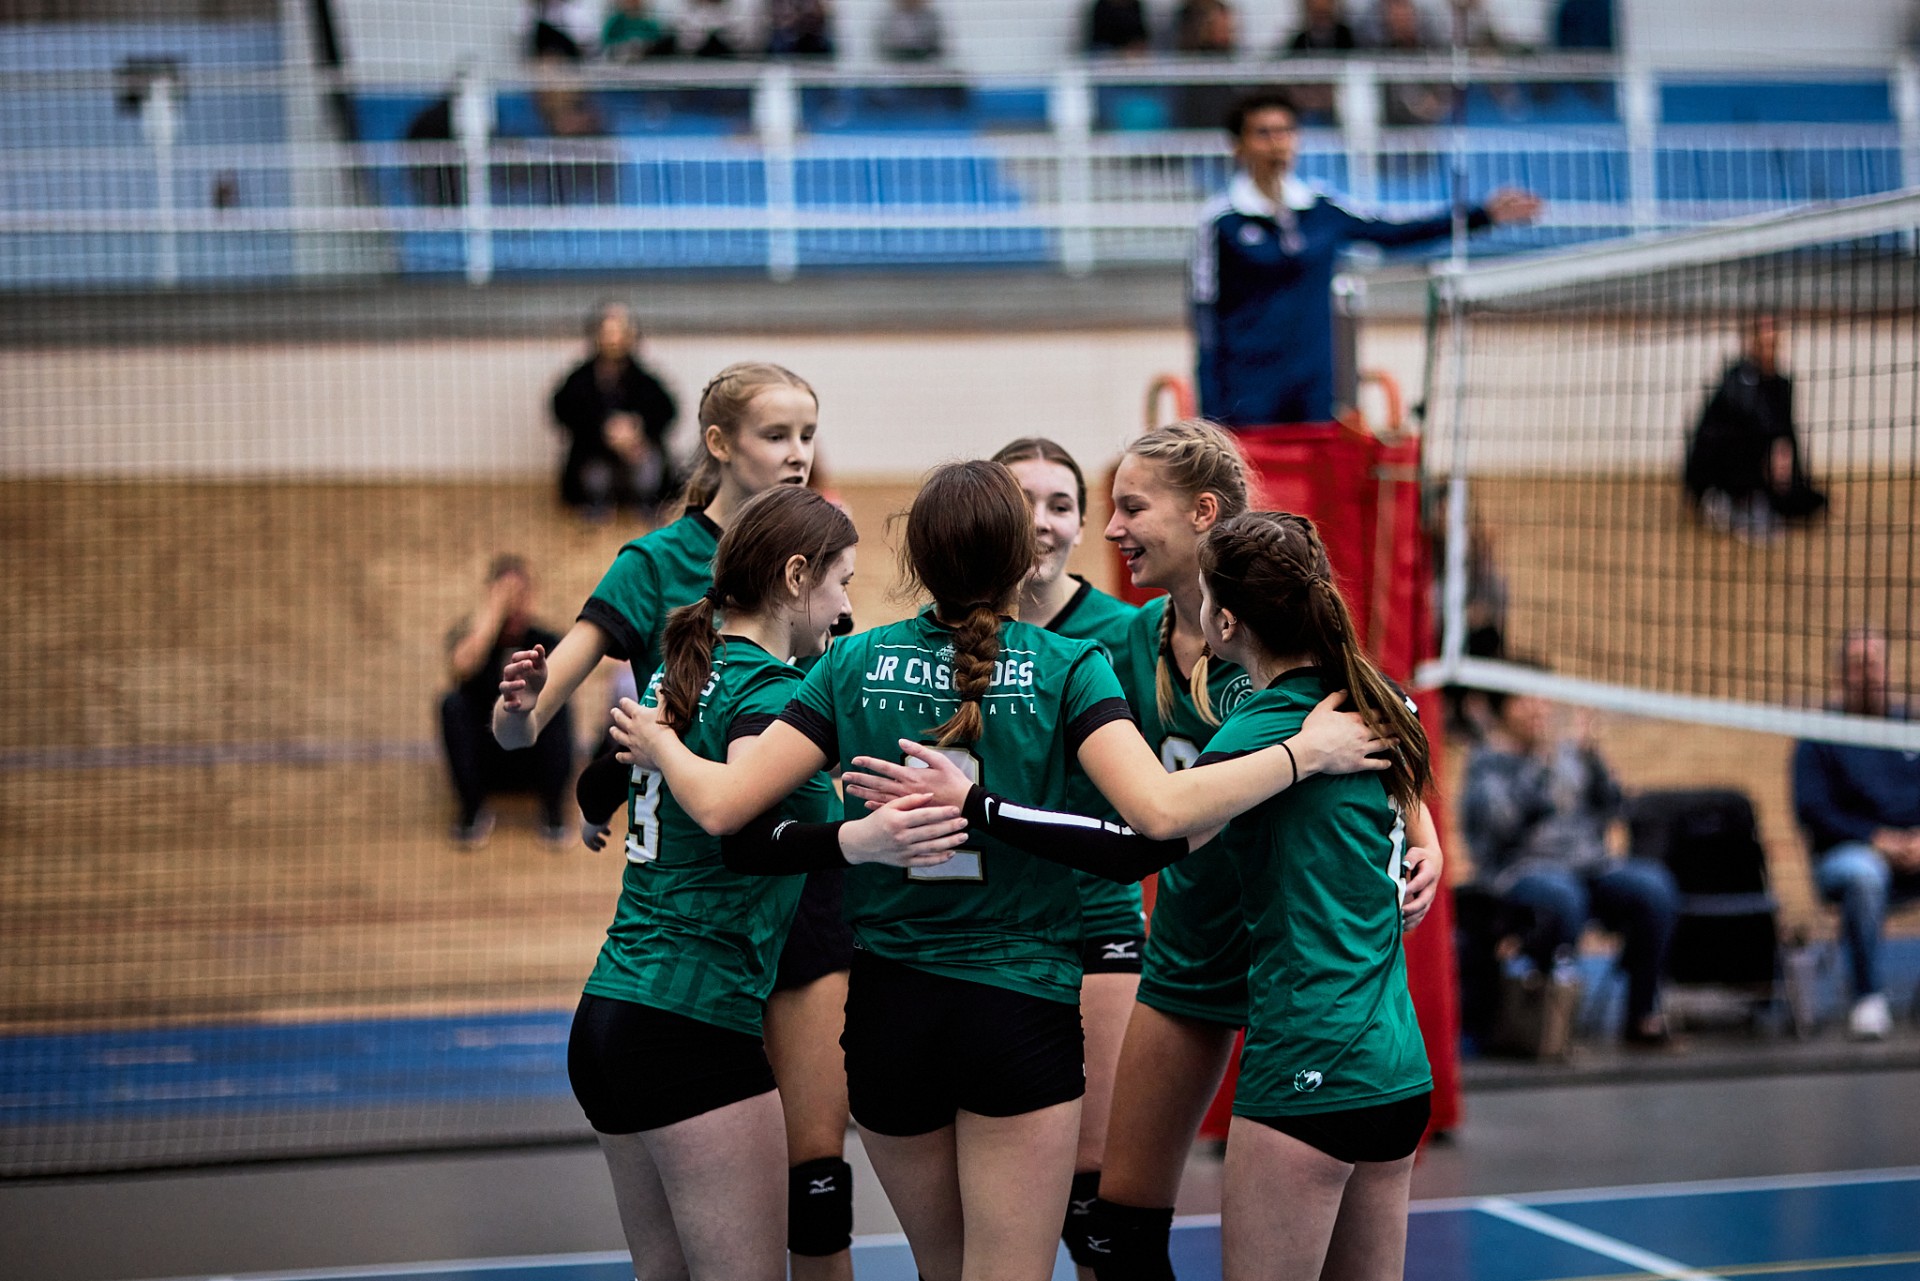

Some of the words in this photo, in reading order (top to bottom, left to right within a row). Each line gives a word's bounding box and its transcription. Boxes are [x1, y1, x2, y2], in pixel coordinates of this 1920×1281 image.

[866, 655, 900, 681] JR
[904, 658, 1034, 690] CASDES
[862, 697, 1037, 717] VOLLEALL
[625, 763, 663, 864] 3
